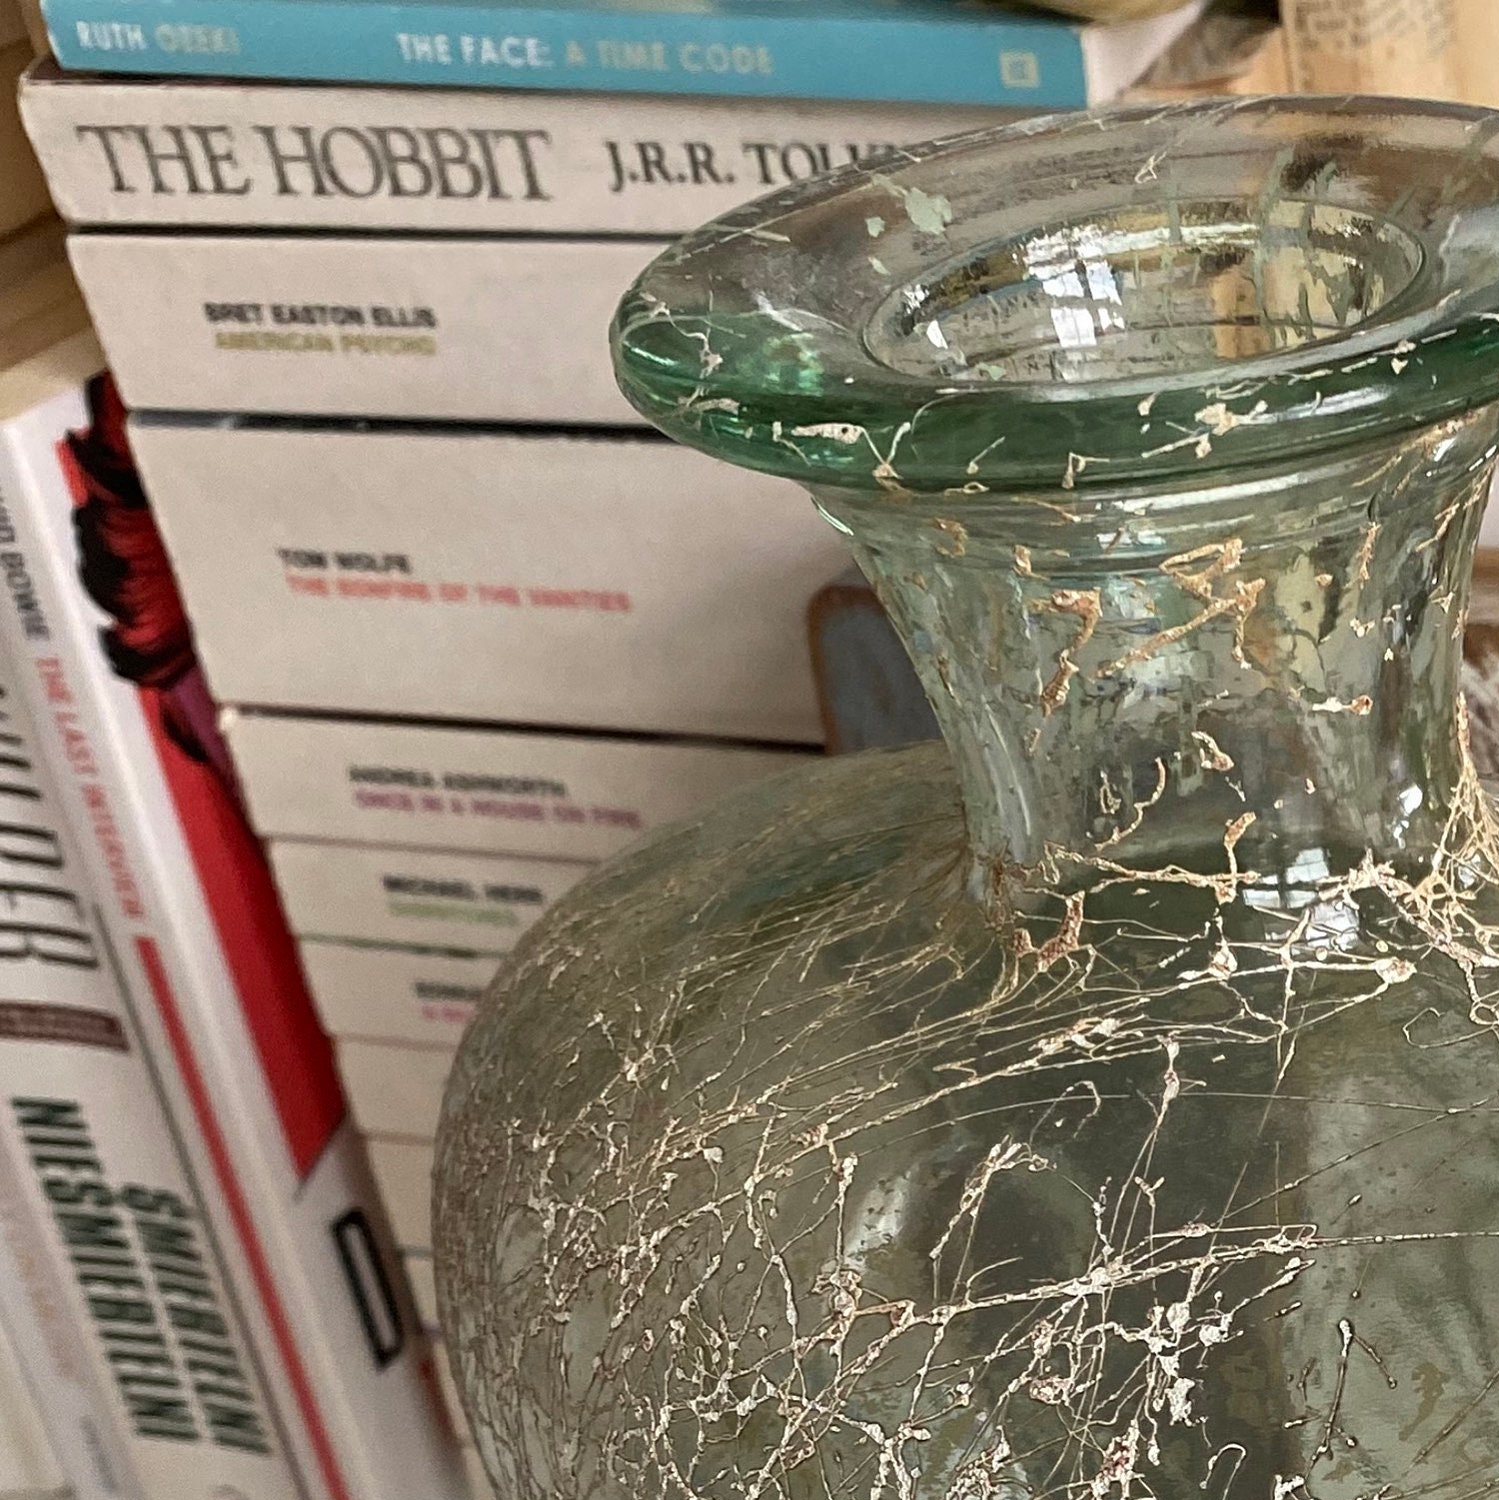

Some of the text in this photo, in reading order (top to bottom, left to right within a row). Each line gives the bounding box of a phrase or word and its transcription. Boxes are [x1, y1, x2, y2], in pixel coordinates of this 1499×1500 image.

[76, 20, 147, 51] RUTH
[396, 33, 452, 65] THE
[564, 41, 587, 66] A
[597, 41, 670, 72] TIME
[679, 44, 776, 75] CODE
[75, 124, 552, 200] THE HOBBIT
[605, 140, 736, 193] J.R.R.
[55, 711, 98, 775] LAST
